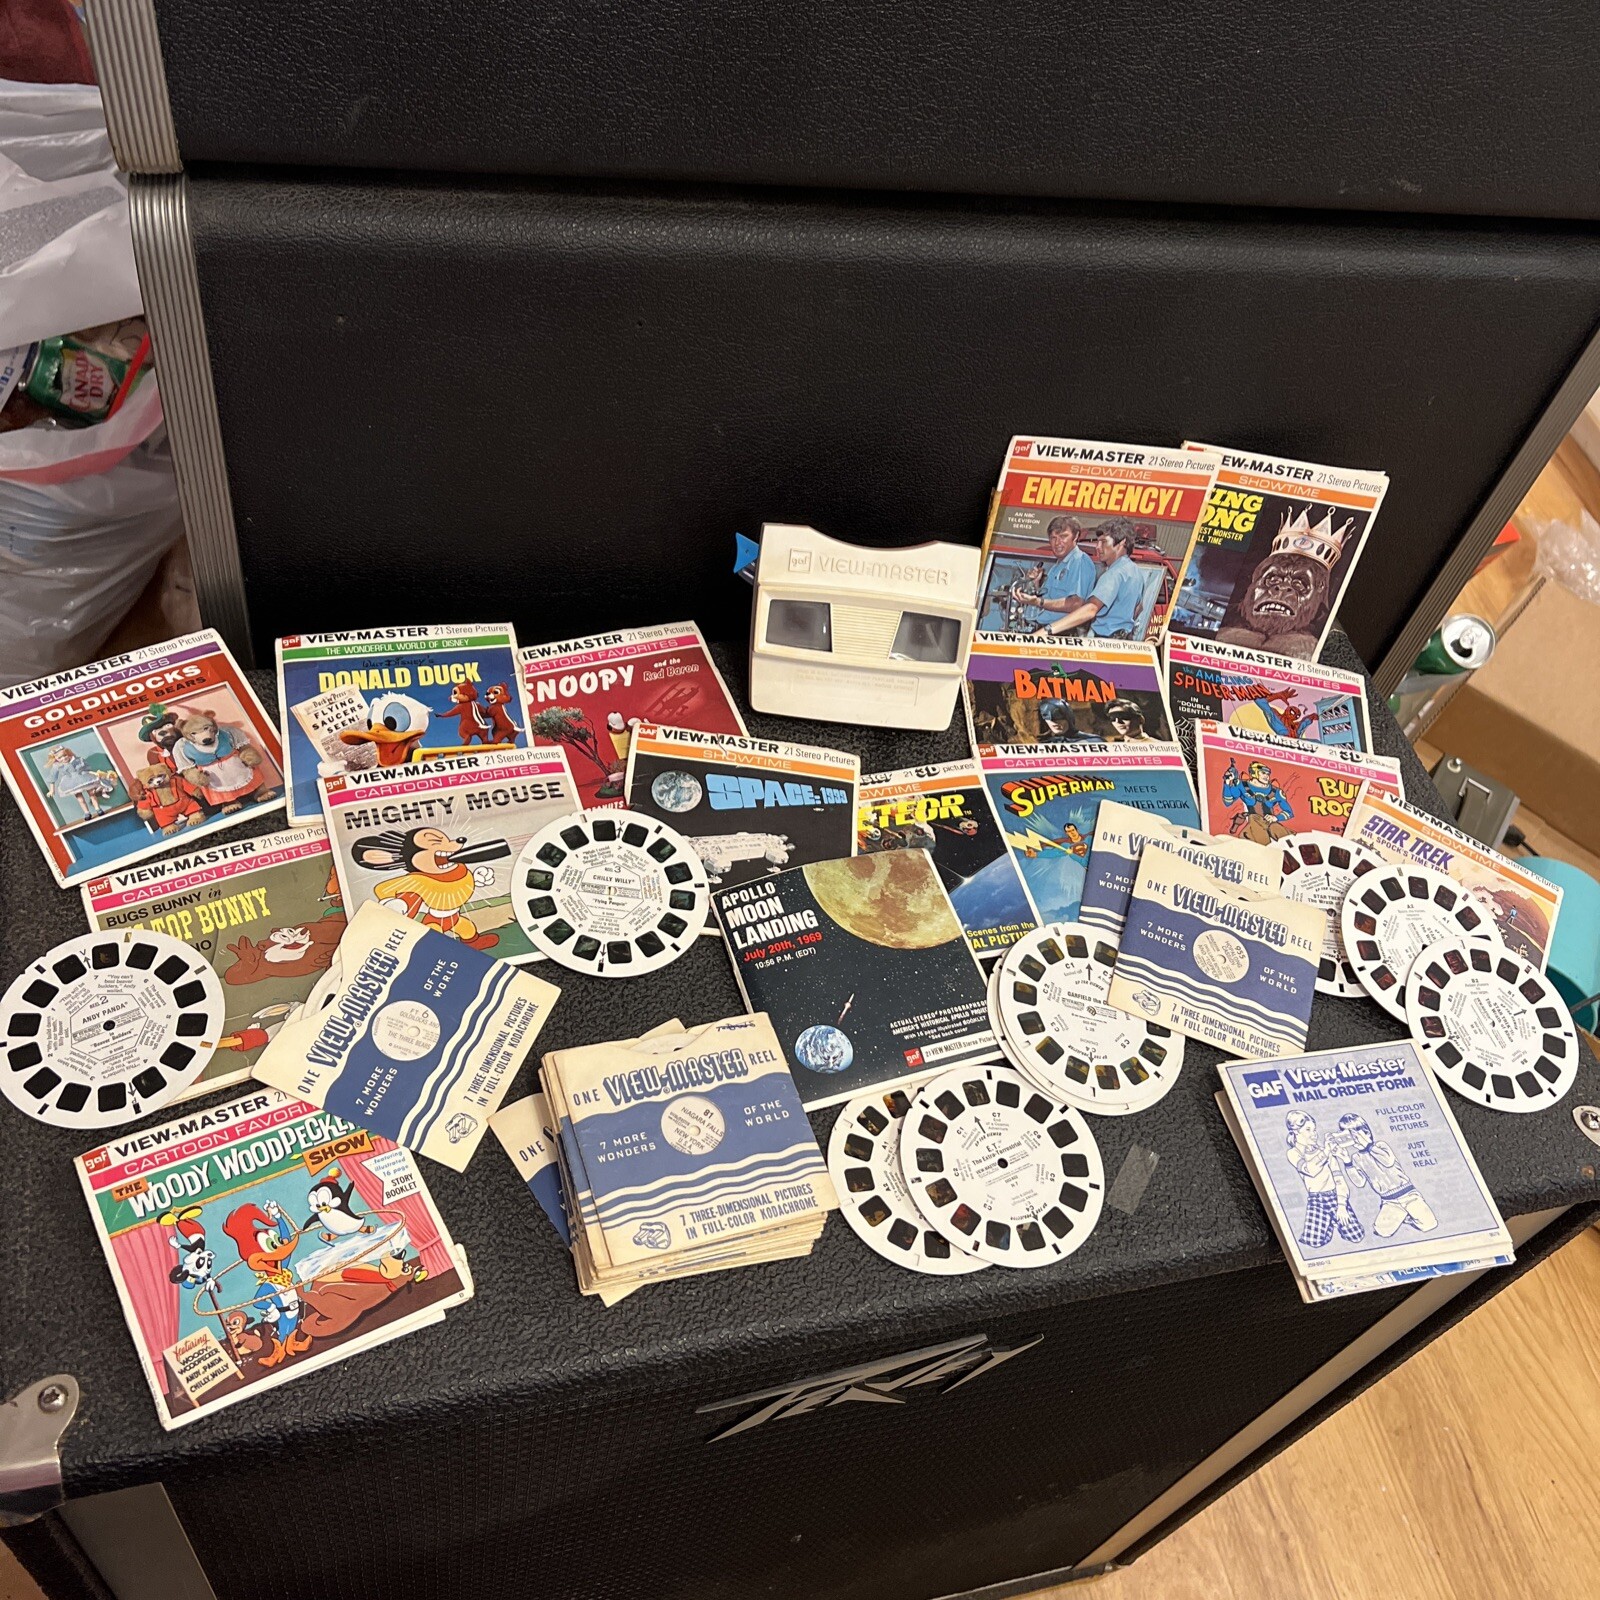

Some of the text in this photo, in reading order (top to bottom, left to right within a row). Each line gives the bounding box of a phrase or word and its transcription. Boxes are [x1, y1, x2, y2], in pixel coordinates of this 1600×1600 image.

[90, 365, 104, 398] DRY
[1036, 444, 1215, 471] VIEW-MASTER 21 Stereo Pictures
[1070, 465, 1152, 480] SHOWTIME
[1021, 477, 1184, 516] EMERGENCY!
[1238, 476, 1321, 498] SHOWTIME
[1007, 517, 1040, 525] TELEVISION
[1213, 529, 1243, 541] MONSTER
[326, 638, 470, 655] THE WONDERFUL WORLD OF DISNEY
[319, 661, 481, 693] DONALD DUCK
[643, 664, 699, 682] Red Baron
[654, 660, 671, 668] and
[1190, 654, 1341, 690] CARTOON FAVORITES
[39, 657, 169, 704] CLASSIC TALES
[526, 664, 634, 706] SNOOPY
[1014, 669, 1117, 703] BATMAN
[1174, 671, 1271, 702] SPIDER-MAN
[24, 665, 201, 729] GOLDILOCKS
[30, 676, 207, 739] and the THREE BEARS
[314, 697, 355, 719] FLYING
[312, 703, 364, 730] SAUCERS
[327, 714, 360, 734] SEEN!
[703, 749, 792, 769] SHOWTIME
[903, 762, 975, 778] 21 3D pictures
[1004, 757, 1162, 768] CARTOON FAVORITES
[1225, 739, 1377, 778] CARTOON FAVORITES
[355, 765, 540, 799] CARTOON FAVORITES
[1124, 785, 1158, 793] MEETS
[344, 782, 564, 830] MIGHTY MOUSE
[1003, 776, 1116, 818] SUPERMAN
[1157, 800, 1190, 809] CROOK
[1364, 814, 1455, 871] STAR TREK
[1376, 835, 1408, 859] SPOCK'S
[1410, 853, 1429, 867] TIME
[1421, 825, 1501, 872] SHOWTIME
[593, 874, 613, 883] CHILLY
[106, 908, 149, 928] BUGS
[152, 890, 201, 914] BUNNY
[208, 888, 223, 899] in
[722, 881, 776, 910] APOLLO
[196, 886, 272, 935] BUNNY
[725, 896, 784, 929] MOON
[1147, 879, 1313, 951] ONE VIEW-MASTER REEL
[733, 909, 819, 950] LANDING
[967, 920, 1035, 939] Scenes from the
[1140, 929, 1187, 951] WONDERS
[743, 931, 823, 962] July 20th, 1969
[754, 947, 817, 970] 10:56 P.M. (EDT)
[1235, 945, 1246, 960] 955
[434, 960, 459, 998] WORLD
[1259, 974, 1297, 994] WORLD
[1067, 991, 1092, 1001] GARFIELD
[82, 1012, 101, 1024] ANDY
[297, 928, 407, 1095] ONE VIEW-MASTER REEL
[892, 1006, 988, 1035] AMERICA'S HISTORICAL APOLLO PROJEC
[387, 1031, 432, 1050] THE THREE BEARS
[1170, 1013, 1179, 1024] IN
[1183, 1018, 1227, 1048] FULL-COLOR
[477, 1003, 539, 1107] IN FULL-COLOR KODACHROME
[573, 1049, 777, 1106] ONE VIEW-MASTER REEL
[1284, 1057, 1406, 1088] View-Master
[364, 1067, 398, 1116] WONDERS
[1292, 1076, 1416, 1103] MAIL ORDER FORM
[681, 1106, 724, 1138] NIAGARA FALLS
[703, 1108, 714, 1119] 81
[745, 1109, 790, 1127] WORLD
[1375, 1102, 1426, 1116] FULL-COLOR
[1389, 1112, 1422, 1122] STEREO
[674, 1127, 705, 1151] NEW YORK
[1389, 1121, 1429, 1132] PICTURES
[309, 1133, 365, 1166] SHOW
[597, 1142, 656, 1163] WONDERS
[600, 1131, 647, 1150] 7 MORE
[1407, 1141, 1426, 1150] JUST
[374, 1157, 406, 1171] illustrated
[972, 1157, 983, 1166] The
[1411, 1150, 1430, 1159] LIKE
[1412, 1158, 1438, 1168] REAL!
[115, 1181, 142, 1197] THE
[385, 1181, 418, 1199] BOOKLET
[390, 1172, 413, 1187] STORY
[680, 1183, 813, 1226] 7 THREE-DIMENSIONAL PICTURES
[685, 1196, 818, 1239] IN FULL-COLOR KODACHROME
[174, 1333, 211, 1361] featuring
[185, 1357, 224, 1384] ANDY PANDA
[190, 1363, 230, 1393] CHILLY WILLY
